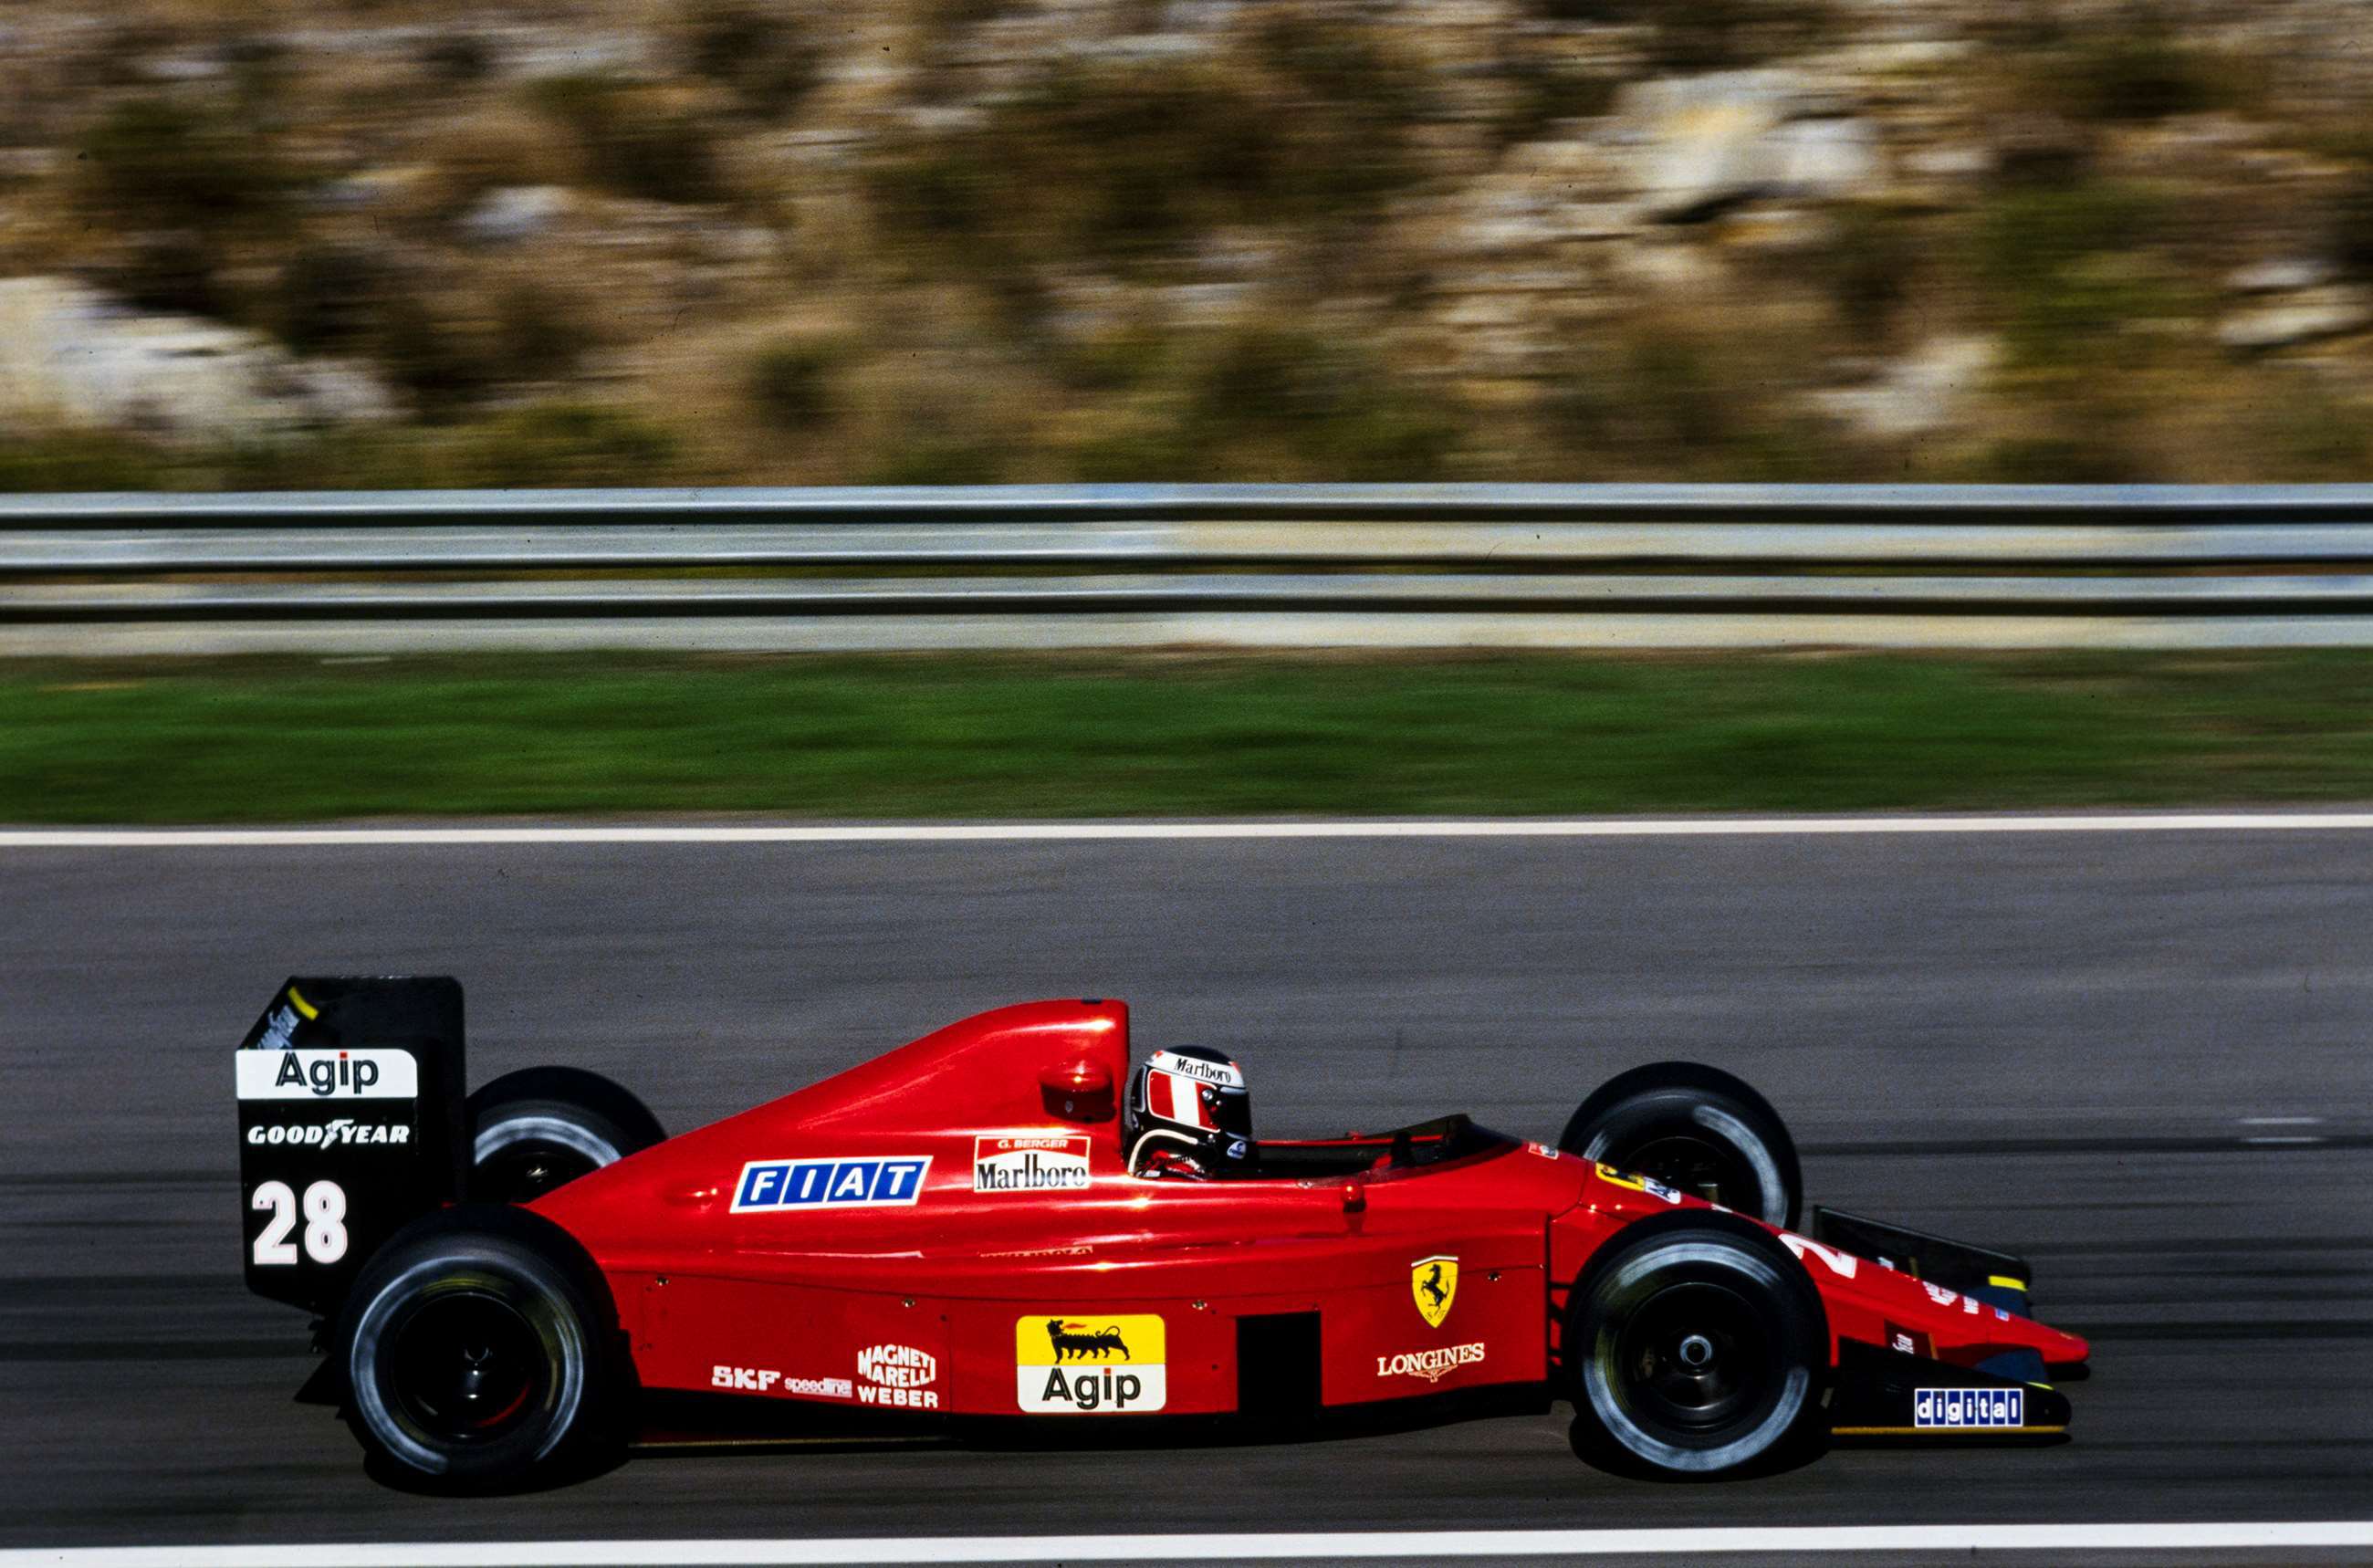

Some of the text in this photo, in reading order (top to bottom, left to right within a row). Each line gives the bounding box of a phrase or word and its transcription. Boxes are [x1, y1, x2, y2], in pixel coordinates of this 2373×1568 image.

[275, 1051, 380, 1096] Agip
[1174, 1058, 1231, 1083] Marlboro
[247, 1119, 411, 1151] GOODYEAR
[997, 1139, 1070, 1149] G. BERGER
[749, 1165, 918, 1203] FIAT
[977, 1153, 1087, 1190] Marlboro
[252, 1180, 349, 1266] 28
[858, 1343, 936, 1375] MAGNETI
[858, 1356, 936, 1389] MARELLI
[1376, 1343, 1485, 1377] LONGINES
[711, 1365, 782, 1391] SKF
[784, 1376, 852, 1399] speedline
[1042, 1367, 1142, 1415] Agip
[857, 1385, 939, 1408] WEBER
[1917, 1397, 2018, 1423] digital
